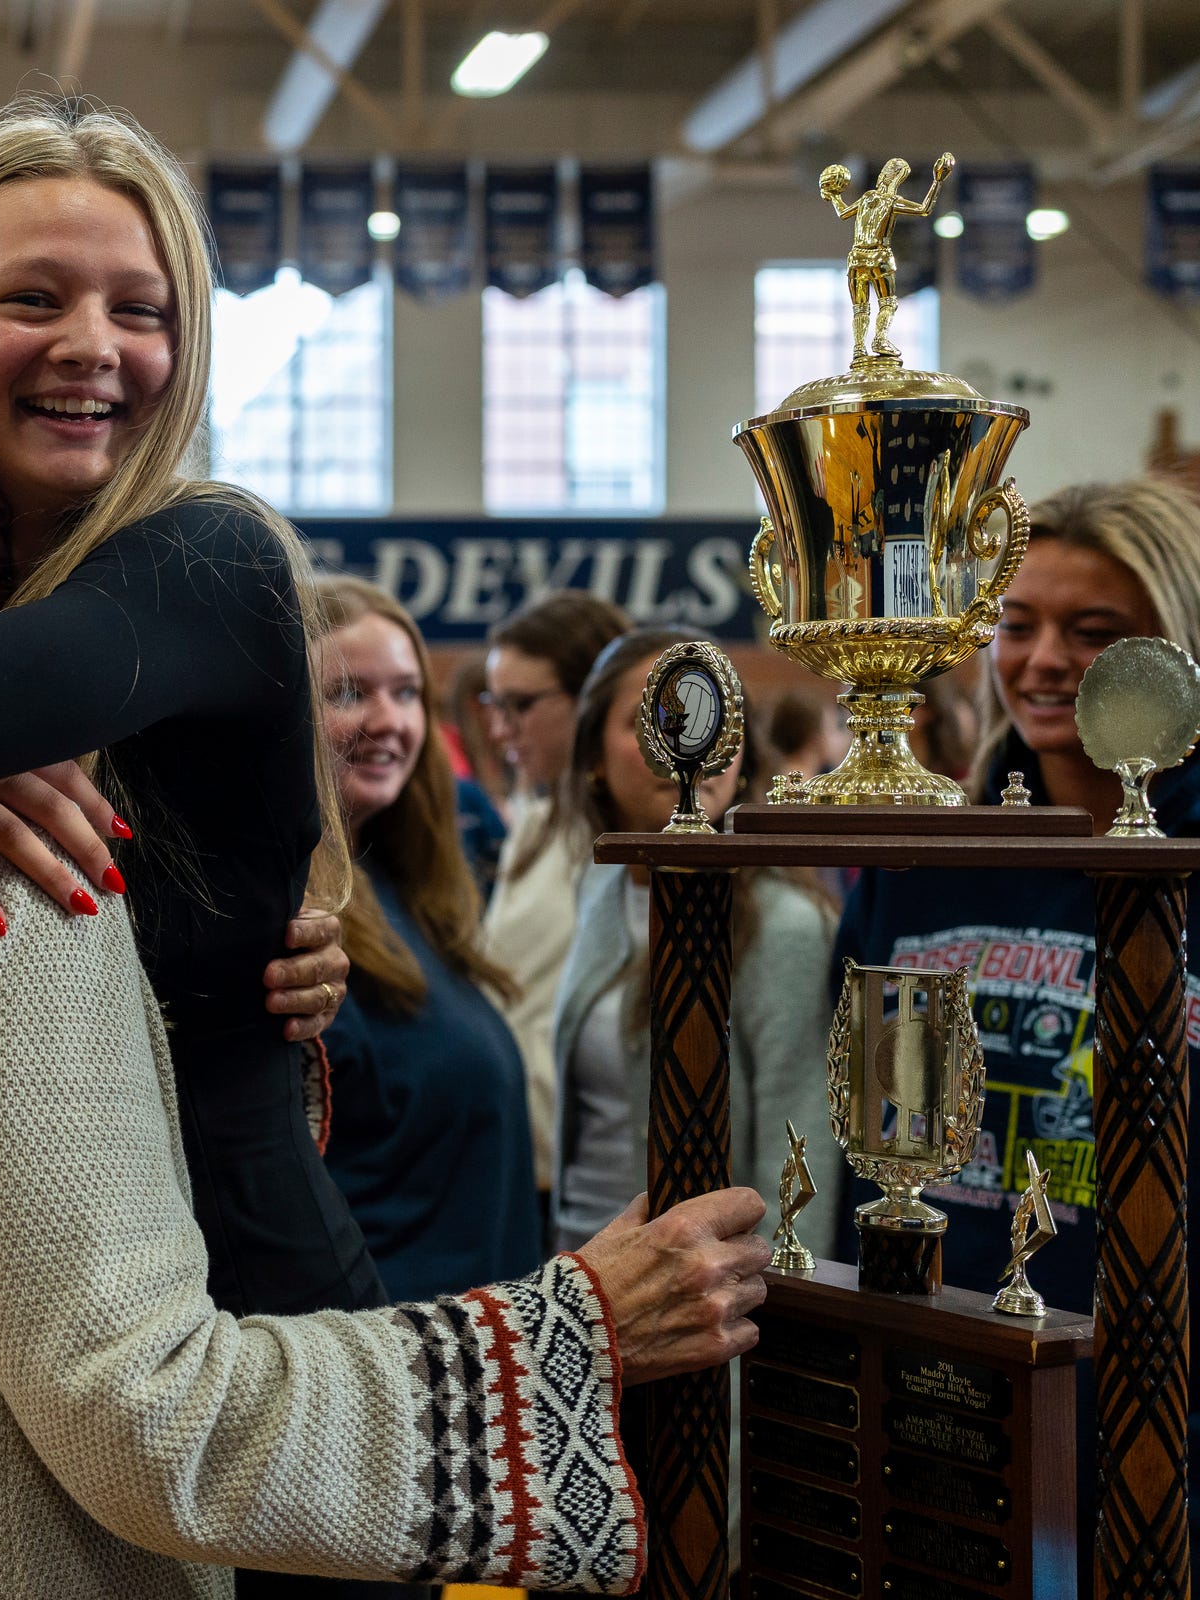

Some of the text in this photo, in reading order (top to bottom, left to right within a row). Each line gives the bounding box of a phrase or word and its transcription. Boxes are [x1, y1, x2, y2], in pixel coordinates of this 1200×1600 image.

[373, 536, 744, 626] DEVILS
[978, 940, 1086, 994] BOWL
[920, 1366, 972, 1388] Maddy Doyle
[937, 1361, 954, 1373] 2011
[900, 1370, 992, 1403] Farmington Hills Mercy
[906, 1381, 987, 1410] Coach: Loretta Vogel
[904, 1414, 986, 1442] AMANDA McKINZIE
[935, 1412, 954, 1425] 2012
[893, 1419, 923, 1435] BATTLE
[926, 1428, 953, 1443] CREEK
[970, 1439, 999, 1456] PHILIP
